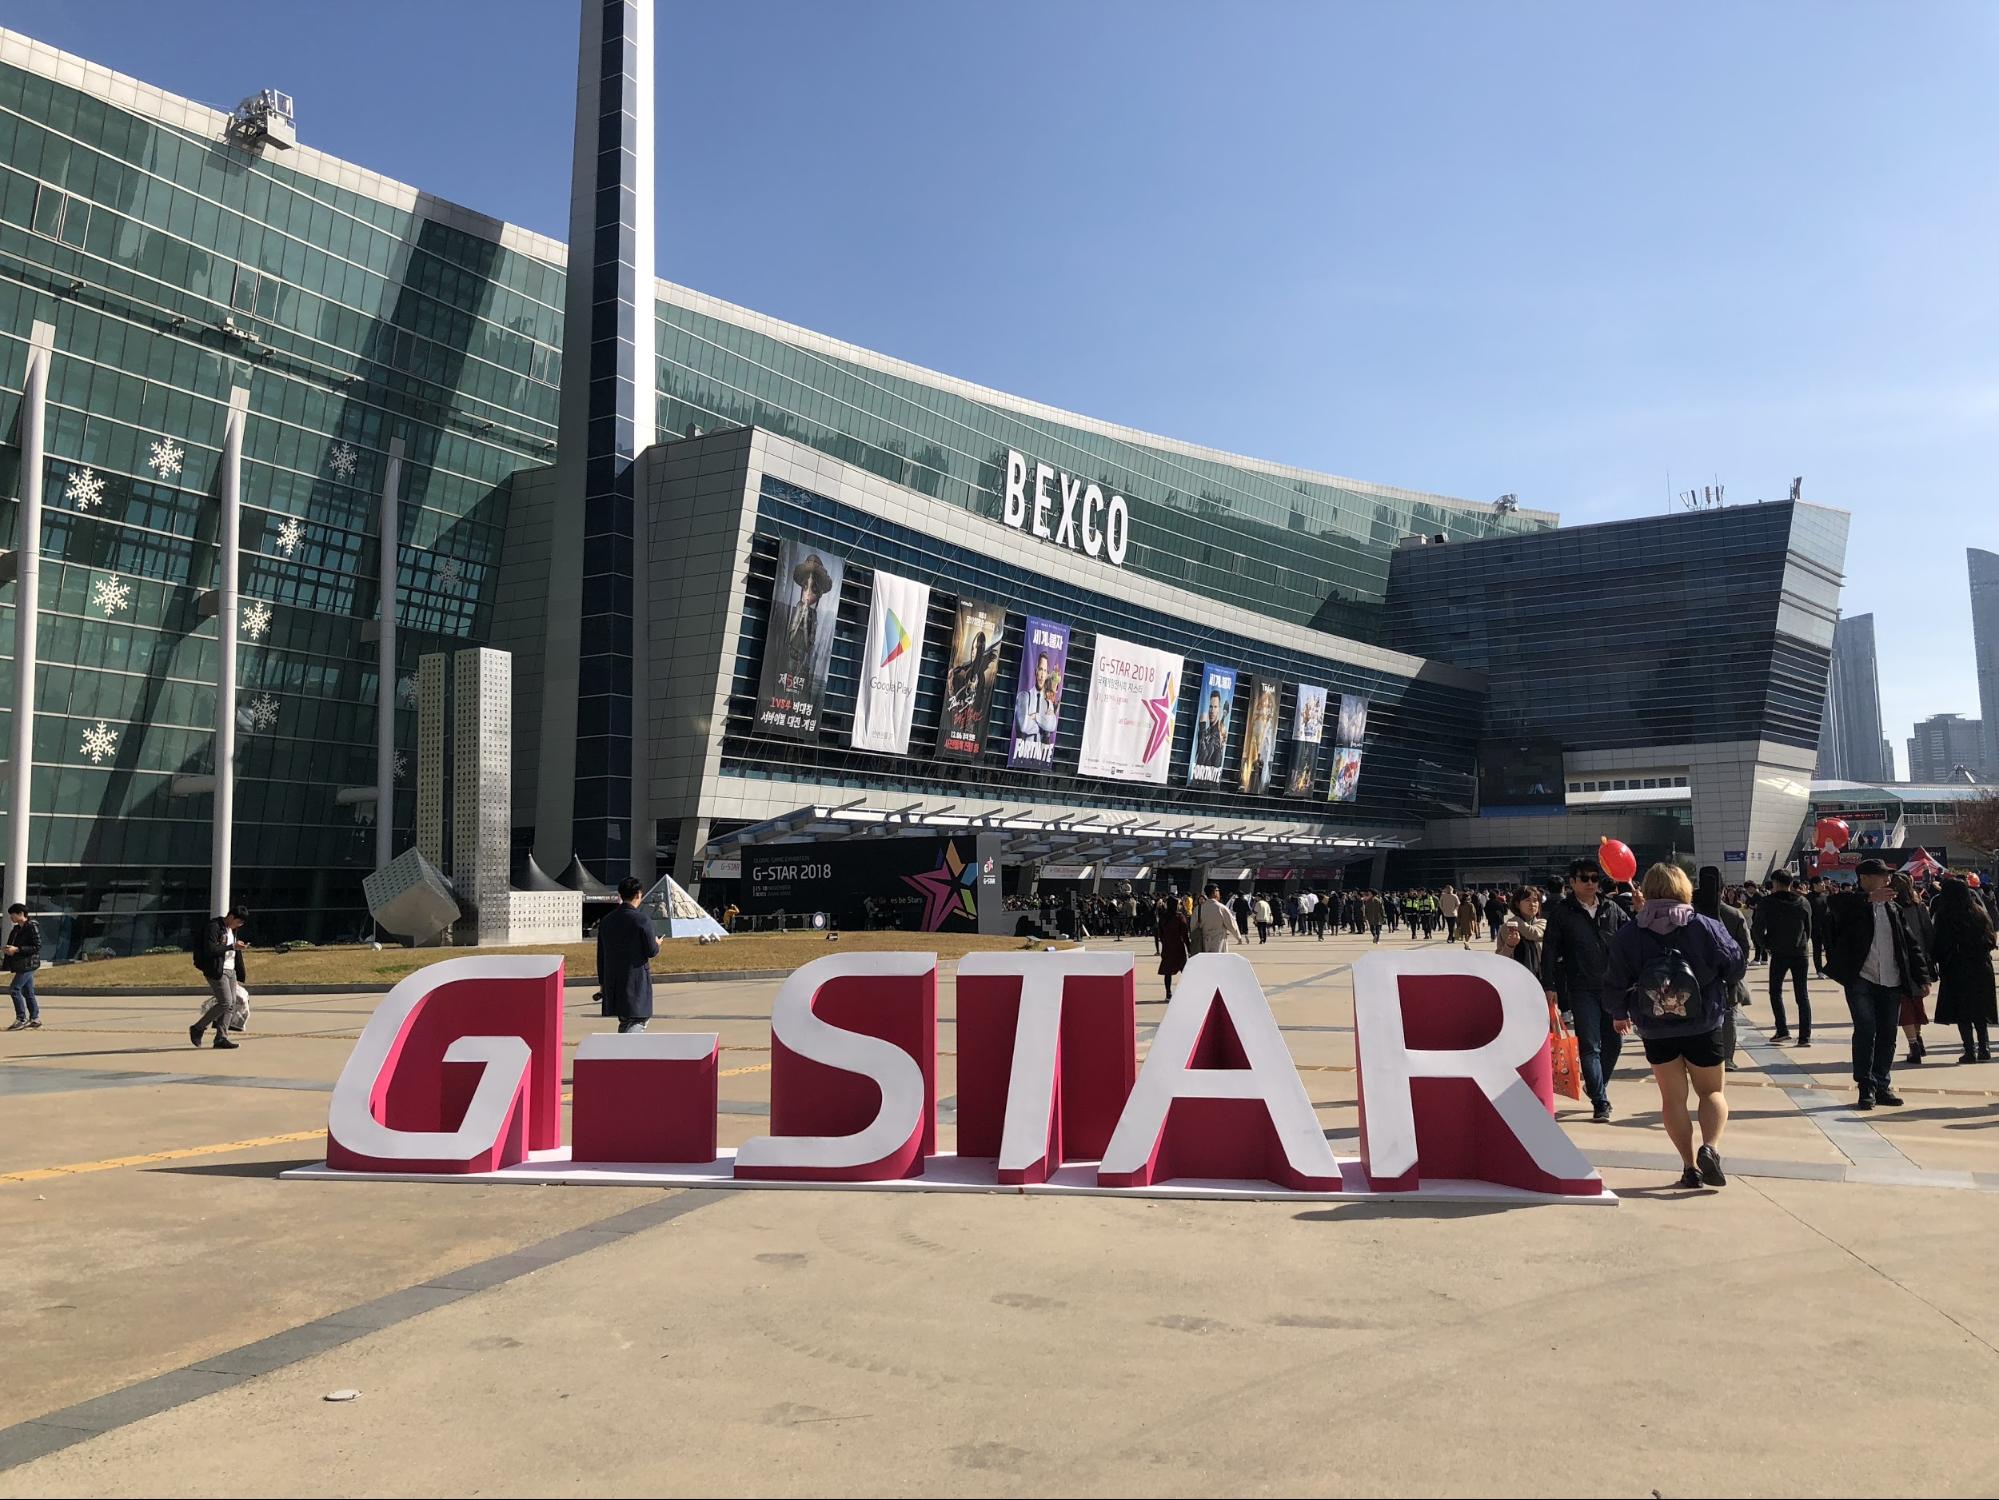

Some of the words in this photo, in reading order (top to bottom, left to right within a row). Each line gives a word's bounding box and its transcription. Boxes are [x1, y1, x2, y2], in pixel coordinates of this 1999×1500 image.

[1004, 450, 1128, 565] BEXCO
[1100, 656, 1131, 678] G-STAR
[1132, 664, 1155, 682] 2018
[870, 676, 895, 694] Google
[897, 681, 912, 697] Play
[761, 711, 786, 726] 서바이벌
[1013, 738, 1054, 762] FORTNITE
[1190, 762, 1222, 783] FORTNITE
[753, 866, 798, 880] G-STAR
[801, 864, 832, 879] 2018
[328, 950, 1602, 1190] G-STAR
